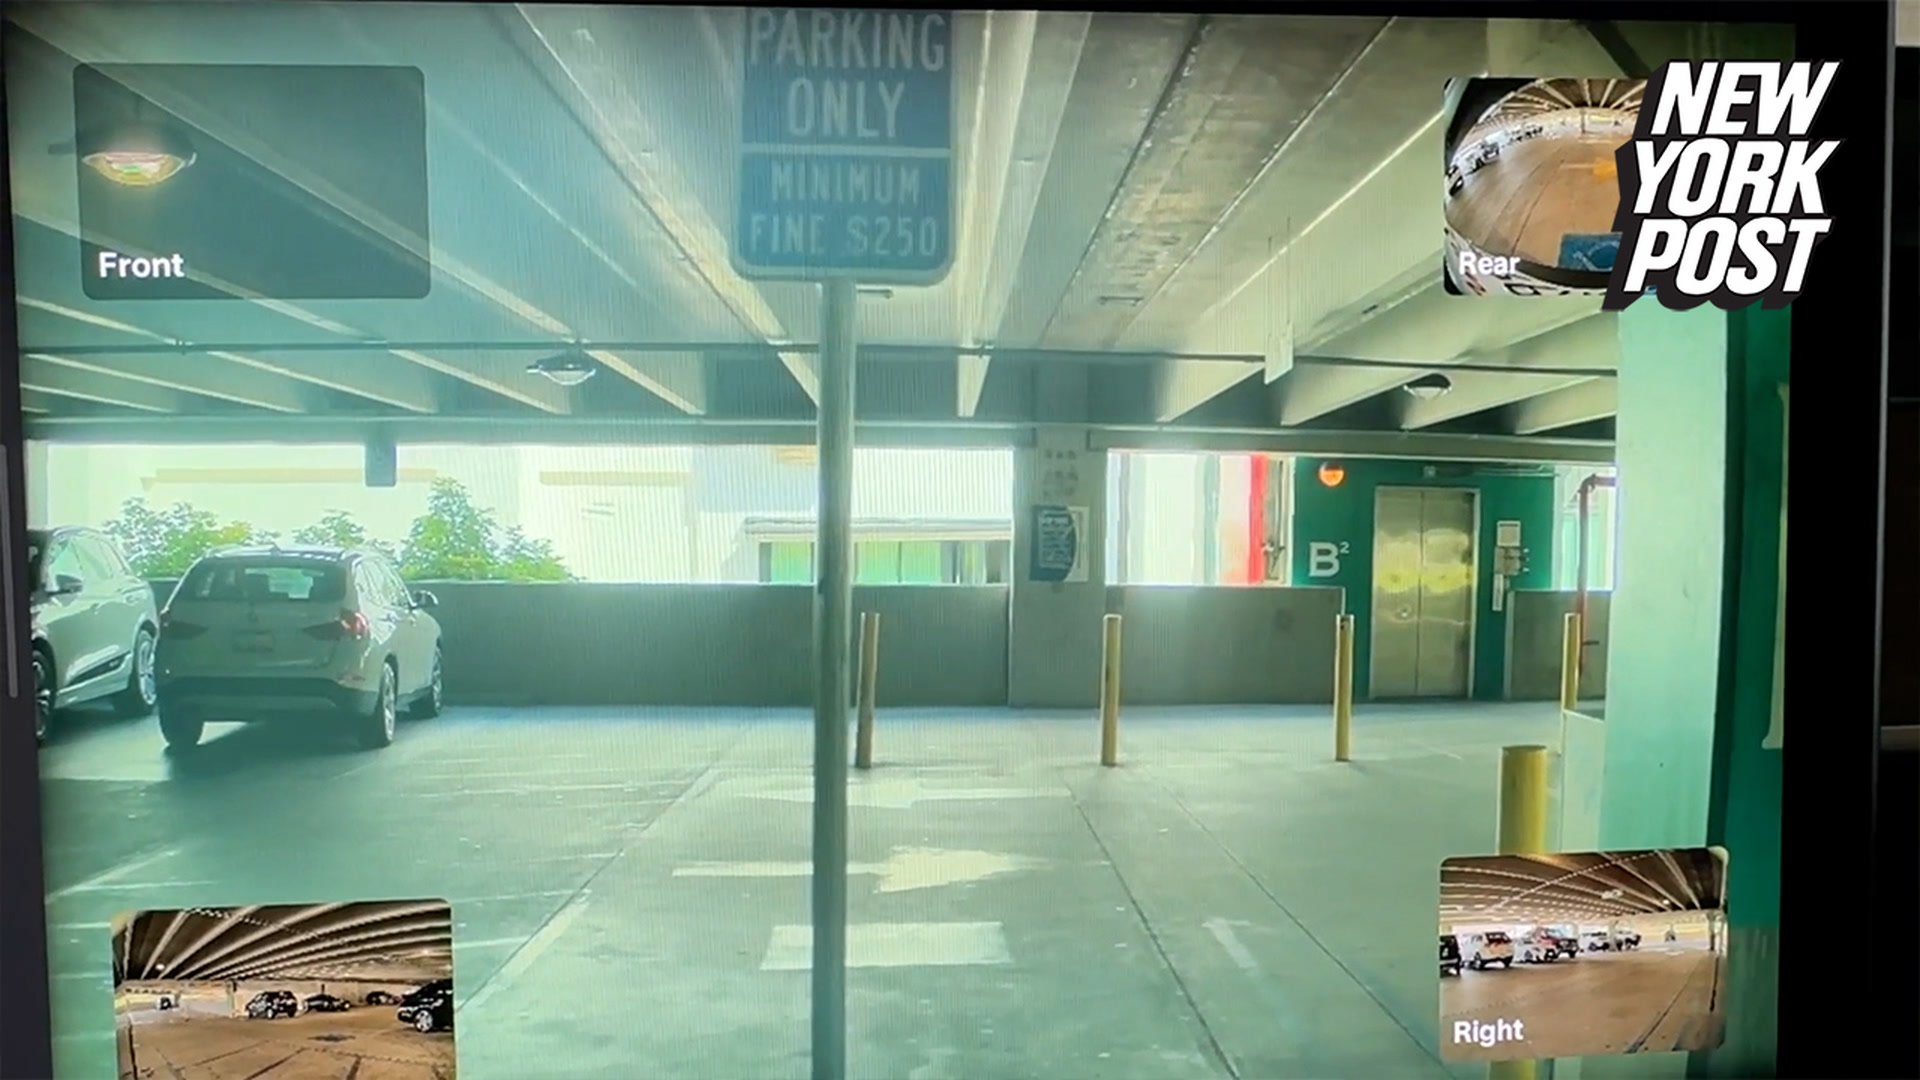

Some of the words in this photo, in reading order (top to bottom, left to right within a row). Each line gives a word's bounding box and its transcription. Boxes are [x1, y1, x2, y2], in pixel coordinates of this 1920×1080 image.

[750, 9, 945, 71] PARKING
[787, 77, 905, 138] ONLY
[770, 160, 920, 205] MINIMUM
[751, 213, 825, 255] FINE
[847, 215, 938, 257] $250
[98, 252, 185, 278] Front
[1458, 251, 1520, 276] Rear
[1454, 1019, 1524, 1047] Right
